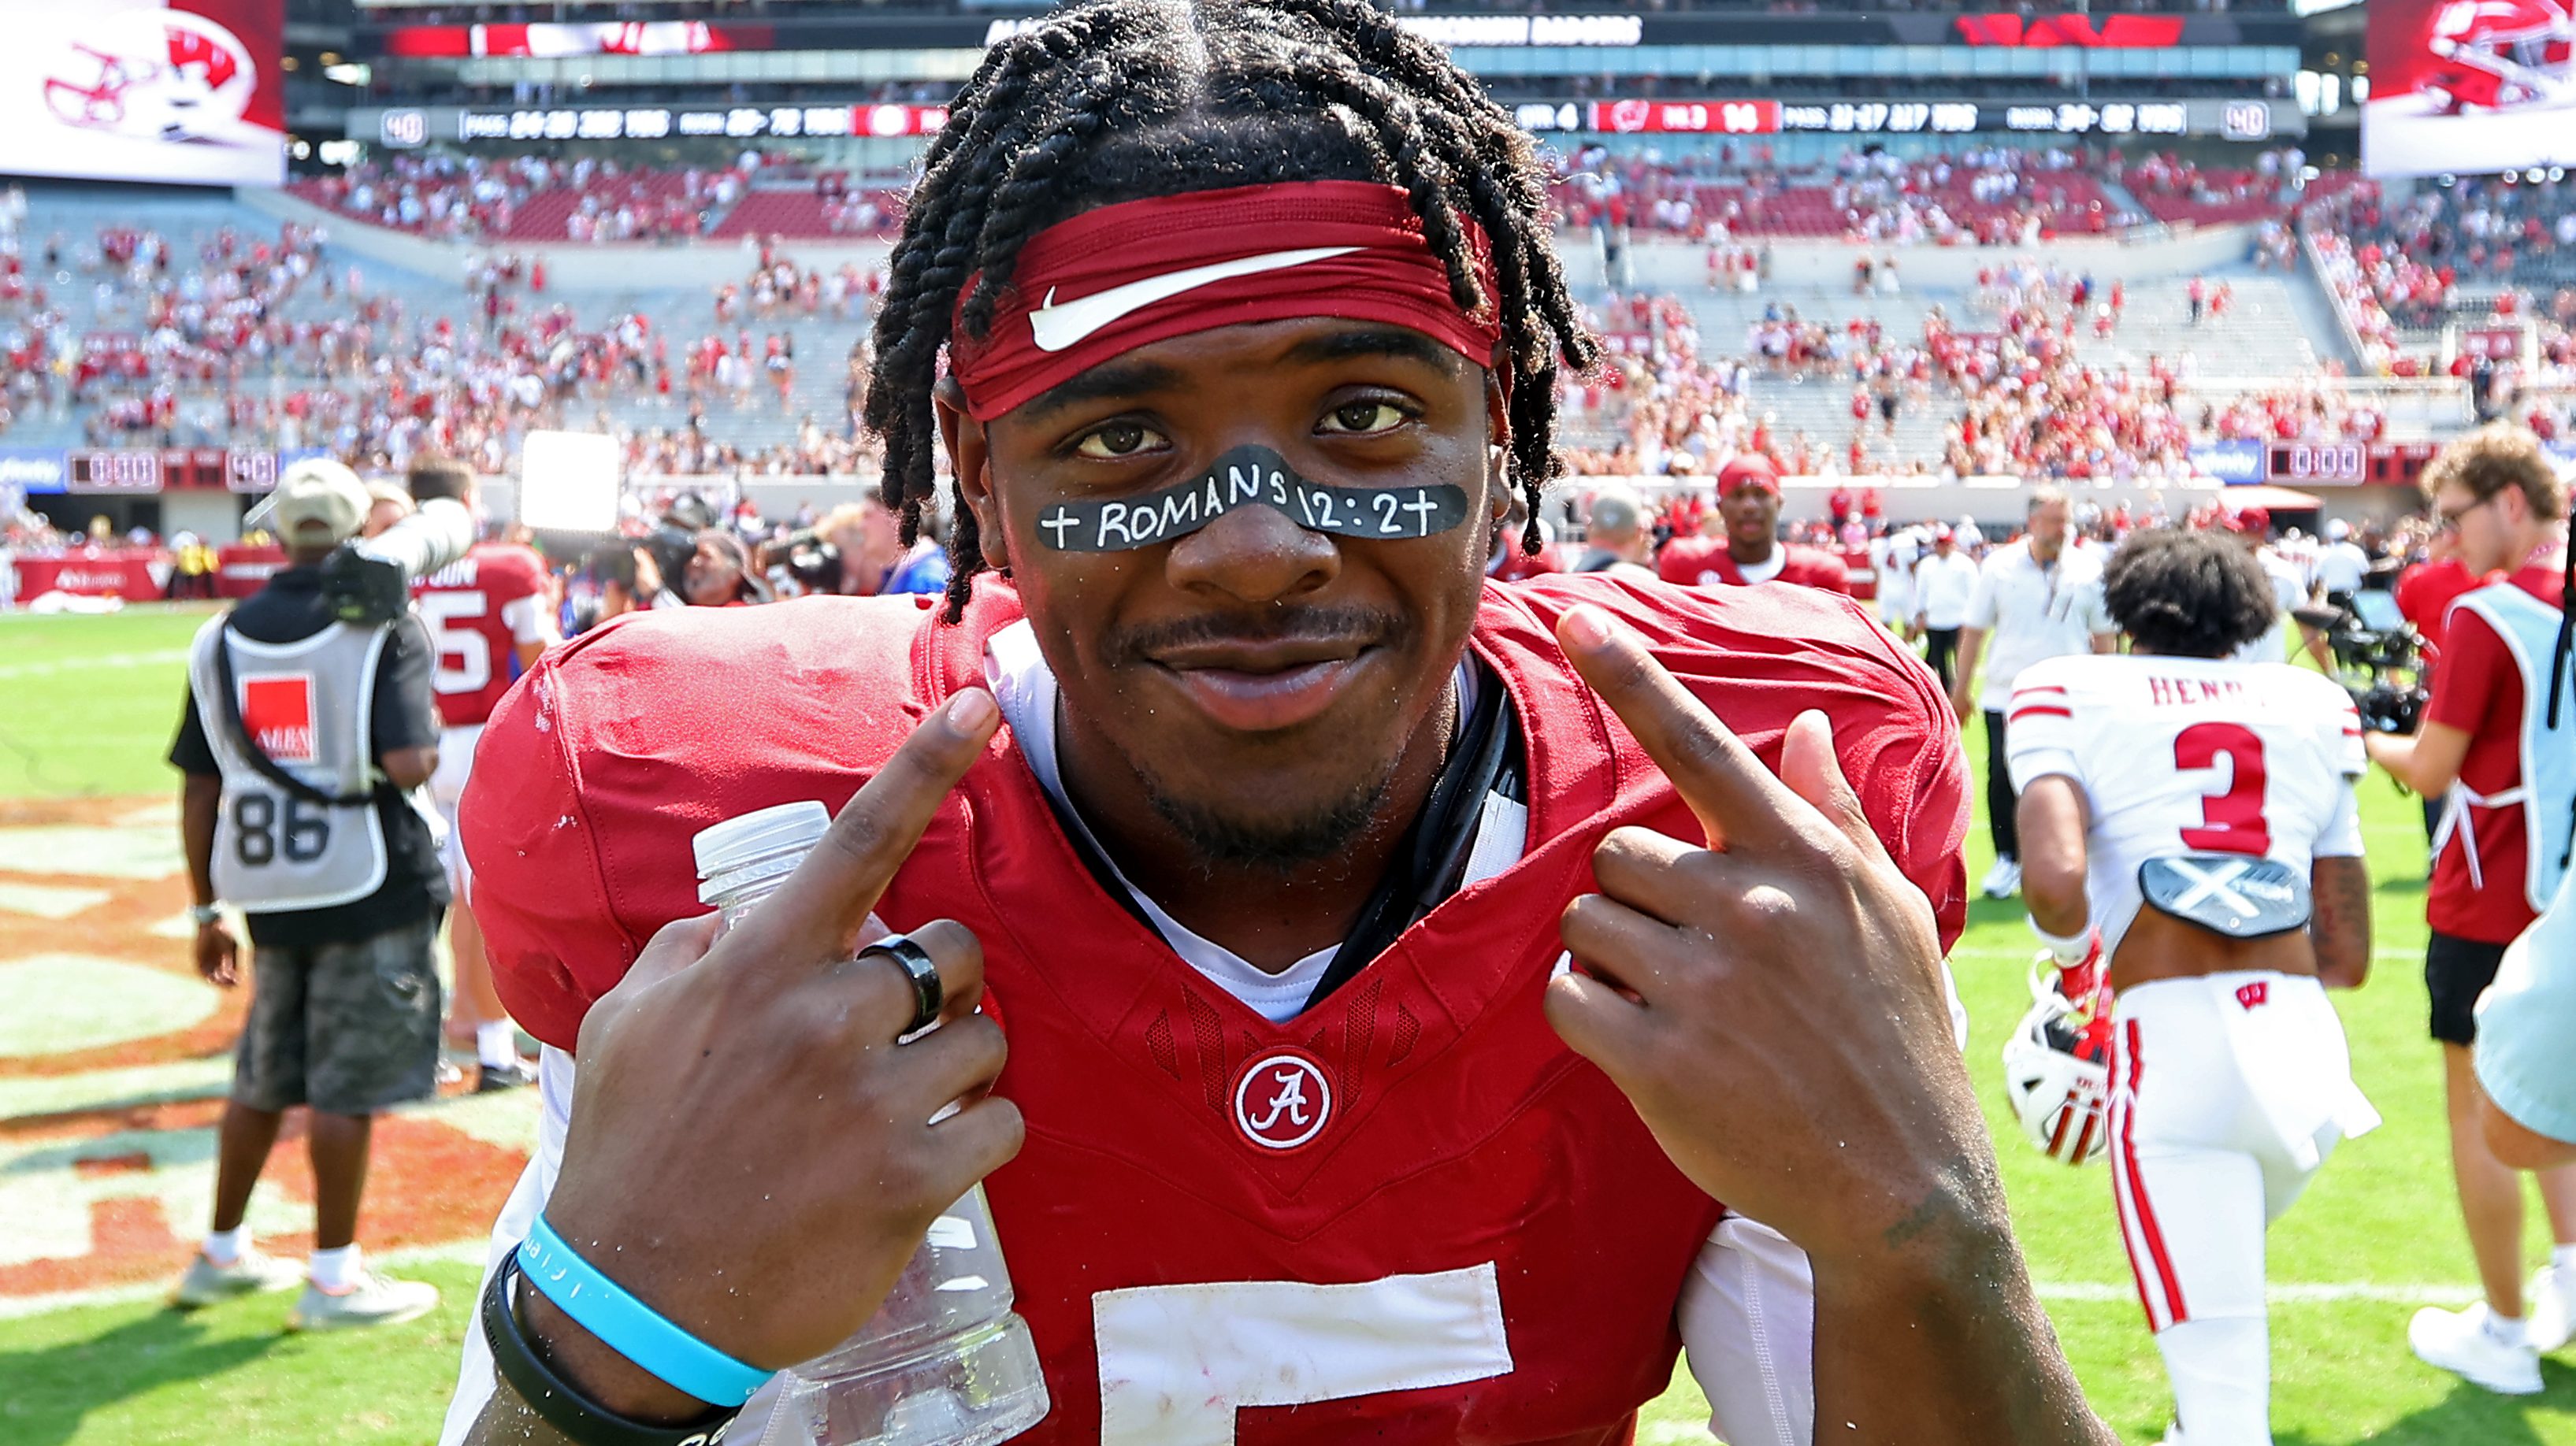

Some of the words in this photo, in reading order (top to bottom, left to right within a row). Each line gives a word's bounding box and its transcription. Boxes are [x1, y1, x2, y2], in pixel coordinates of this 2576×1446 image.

[1097, 463, 1288, 547] ROMANS
[2173, 721, 2272, 857] 3
[236, 793, 329, 866] 86
[1250, 1068, 1310, 1129] A
